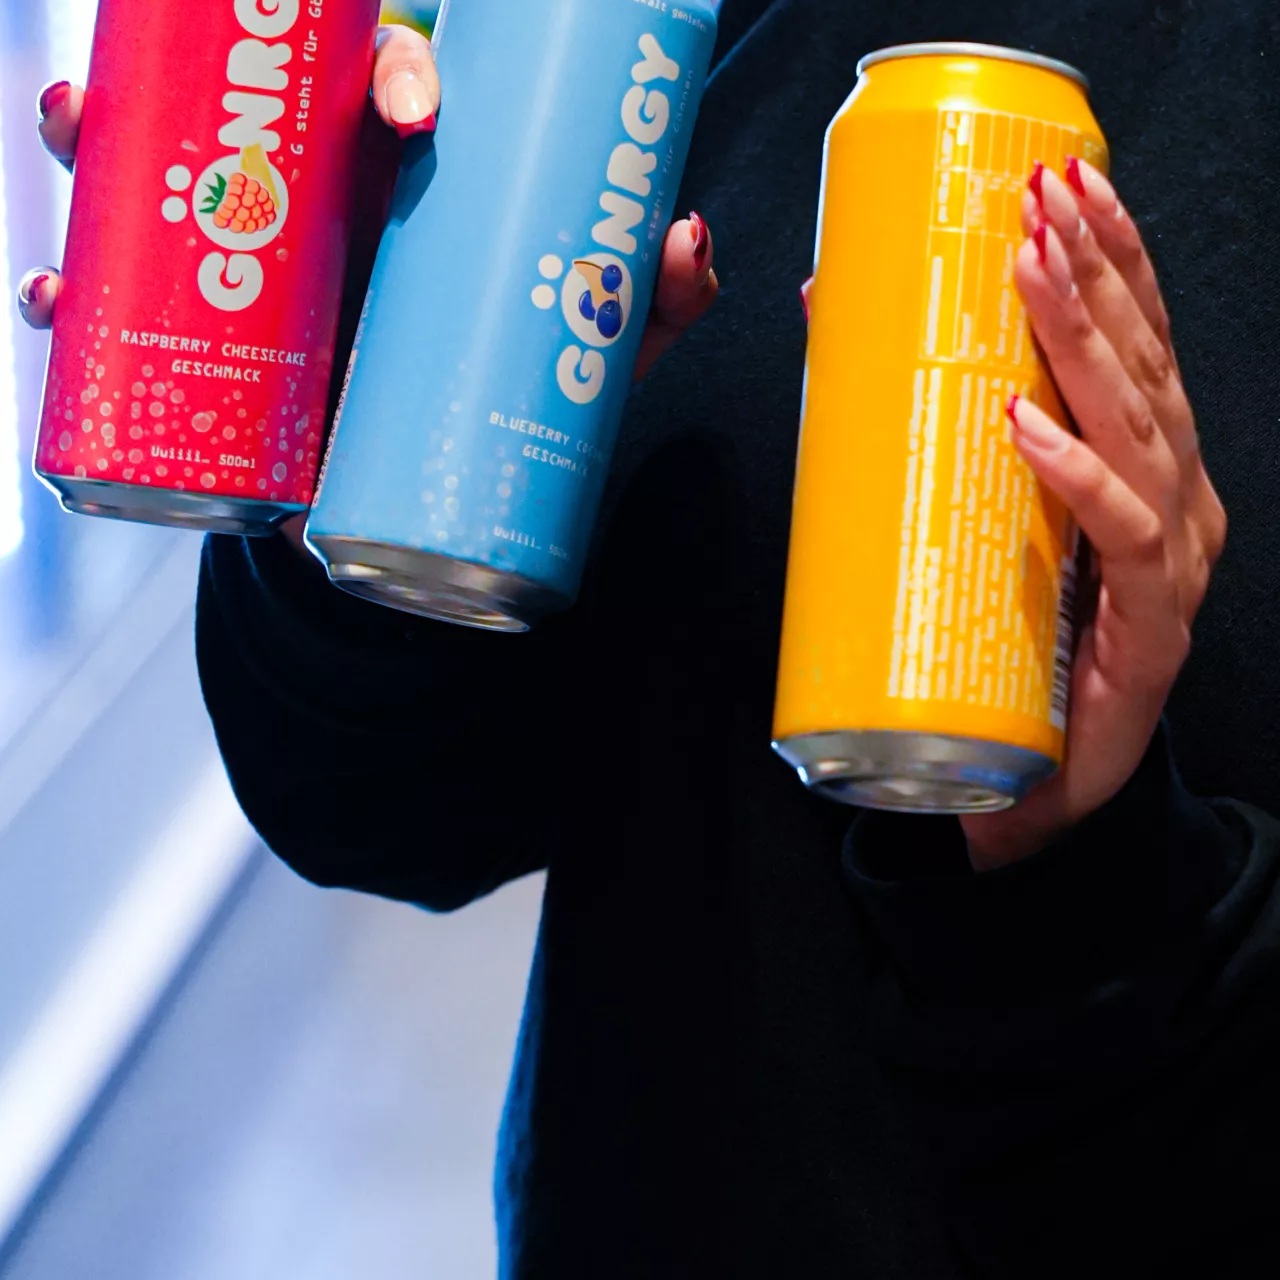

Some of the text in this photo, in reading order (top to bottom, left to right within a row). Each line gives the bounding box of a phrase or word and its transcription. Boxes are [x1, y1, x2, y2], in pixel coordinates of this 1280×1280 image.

[303, 29, 319, 63] für
[296, 74, 313, 133] steht
[290, 143, 304, 156] G
[119, 329, 307, 367] RASPBERRY CHEESECAKE
[170, 358, 262, 383] GESCHMACK
[488, 411, 571, 446] BLUEBERRY
[218, 453, 257, 469] 500ml
